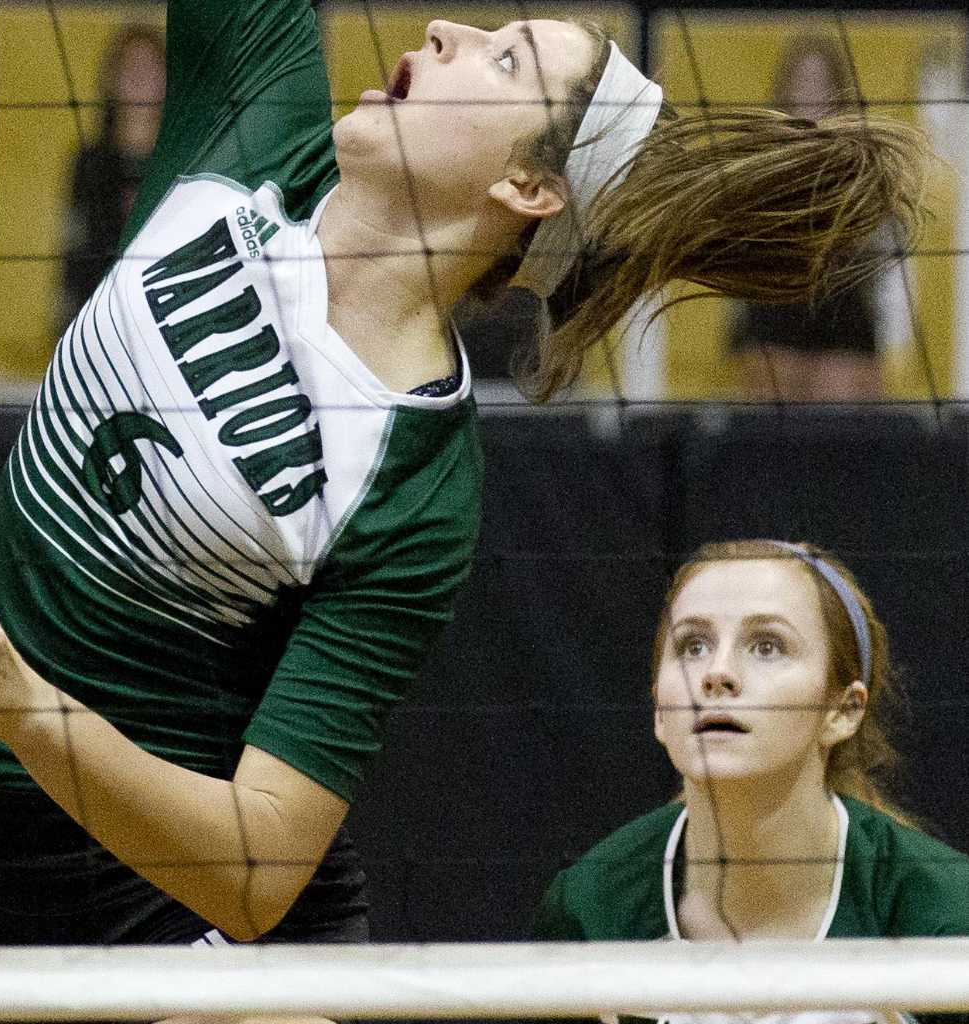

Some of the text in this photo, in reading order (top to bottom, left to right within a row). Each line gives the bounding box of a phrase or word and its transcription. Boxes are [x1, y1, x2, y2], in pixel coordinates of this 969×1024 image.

[236, 206, 261, 258] adidas
[142, 216, 329, 518] WARRIORS
[82, 412, 185, 516] 6
